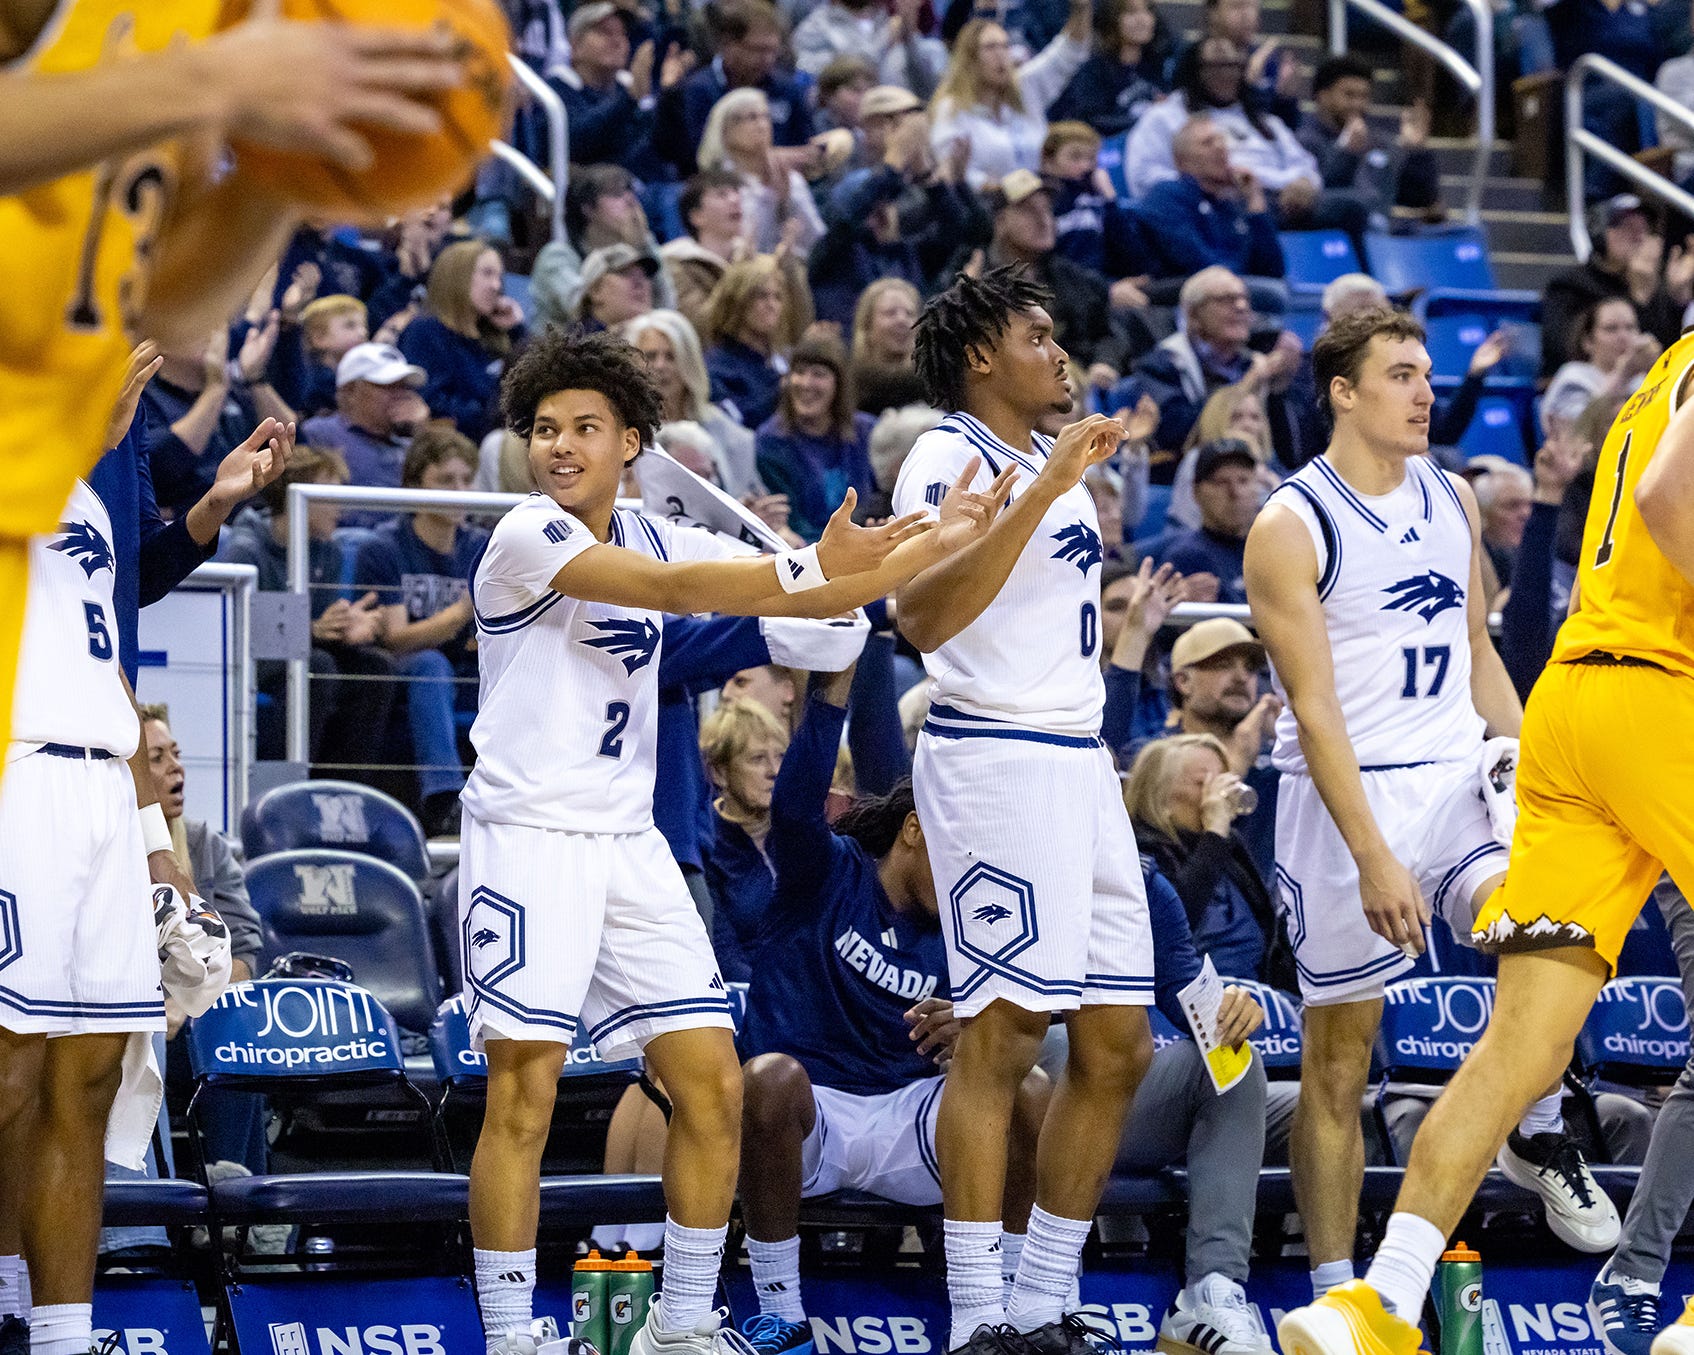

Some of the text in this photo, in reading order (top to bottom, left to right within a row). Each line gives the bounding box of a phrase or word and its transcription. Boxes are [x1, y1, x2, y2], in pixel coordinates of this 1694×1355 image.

[1593, 428, 1632, 570] 1
[83, 600, 113, 661] 5
[1080, 601, 1097, 659] 0
[1400, 645, 1451, 698] 17
[597, 699, 630, 759] 2
[834, 925, 938, 1001] NEVADA
[257, 986, 374, 1038] JOINT
[214, 1038, 388, 1068] chiropractic
[611, 1292, 633, 1324] G
[1080, 1304, 1156, 1342] SB
[91, 1328, 169, 1355] SB
[316, 1324, 443, 1355] NSB
[808, 1316, 932, 1354] NSB
